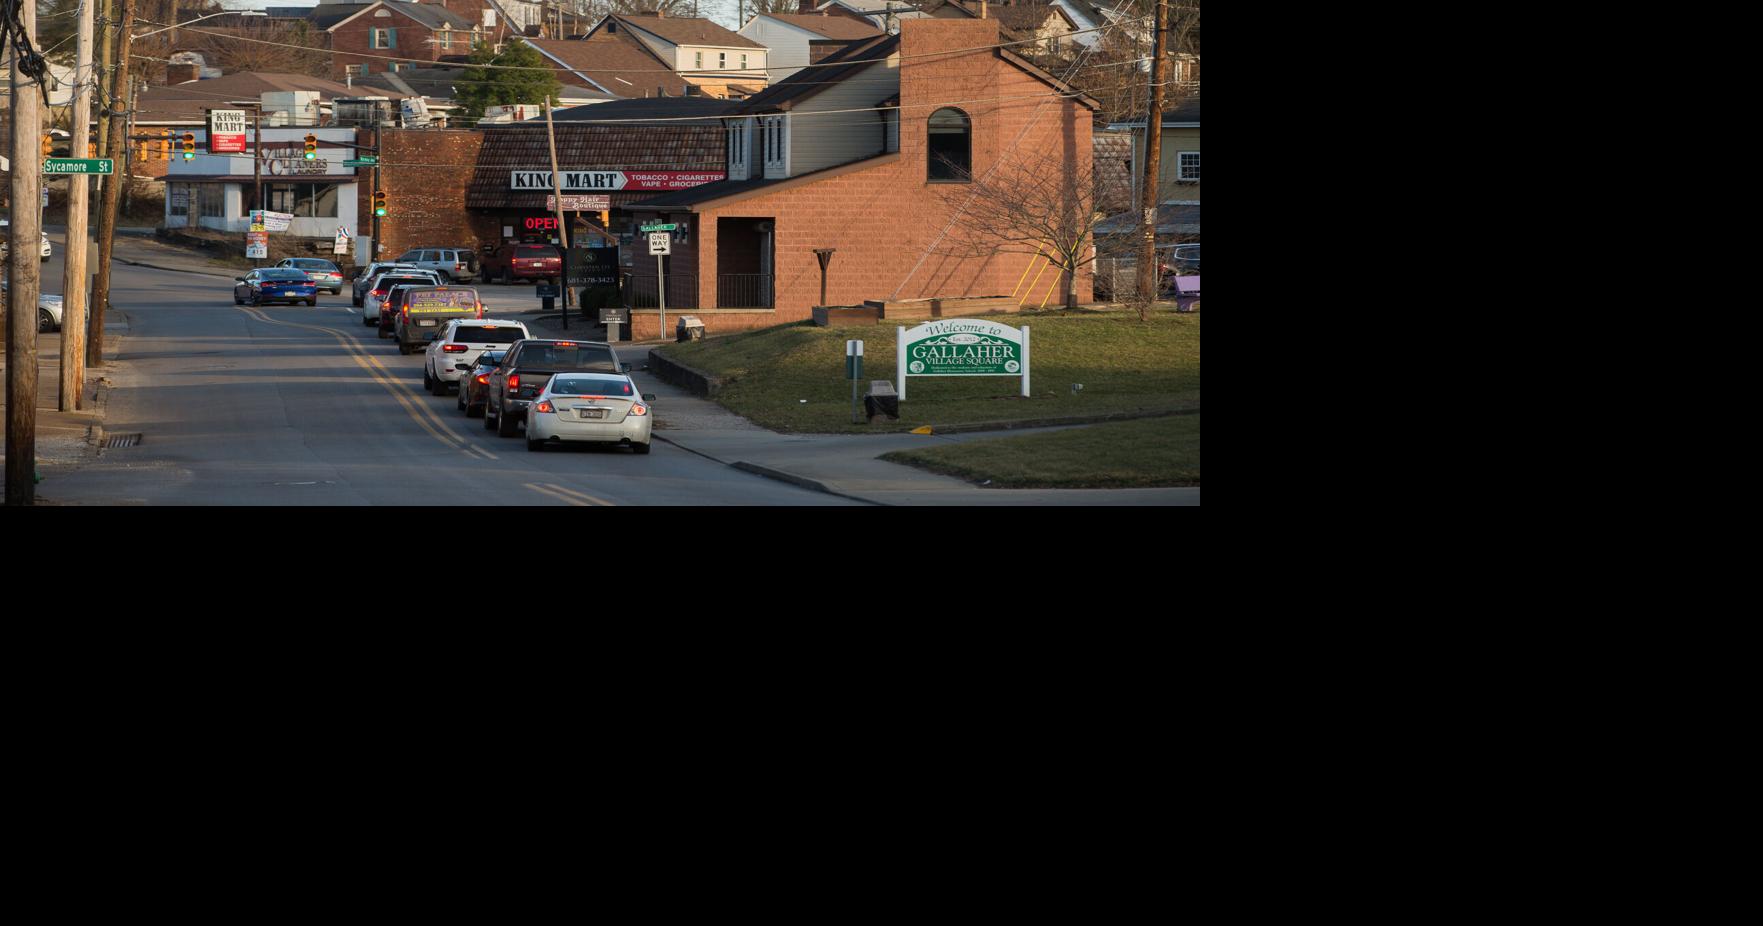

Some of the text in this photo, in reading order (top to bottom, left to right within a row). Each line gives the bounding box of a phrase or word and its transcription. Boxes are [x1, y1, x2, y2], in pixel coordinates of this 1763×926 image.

[216, 112, 240, 122] KING
[214, 122, 244, 131] MART
[46, 160, 108, 173] Sycamore St
[566, 173, 617, 188] MART
[925, 321, 1002, 335] Welcome to
[912, 346, 1015, 358] GALLAHER
[966, 358, 1004, 366] SQUARE
